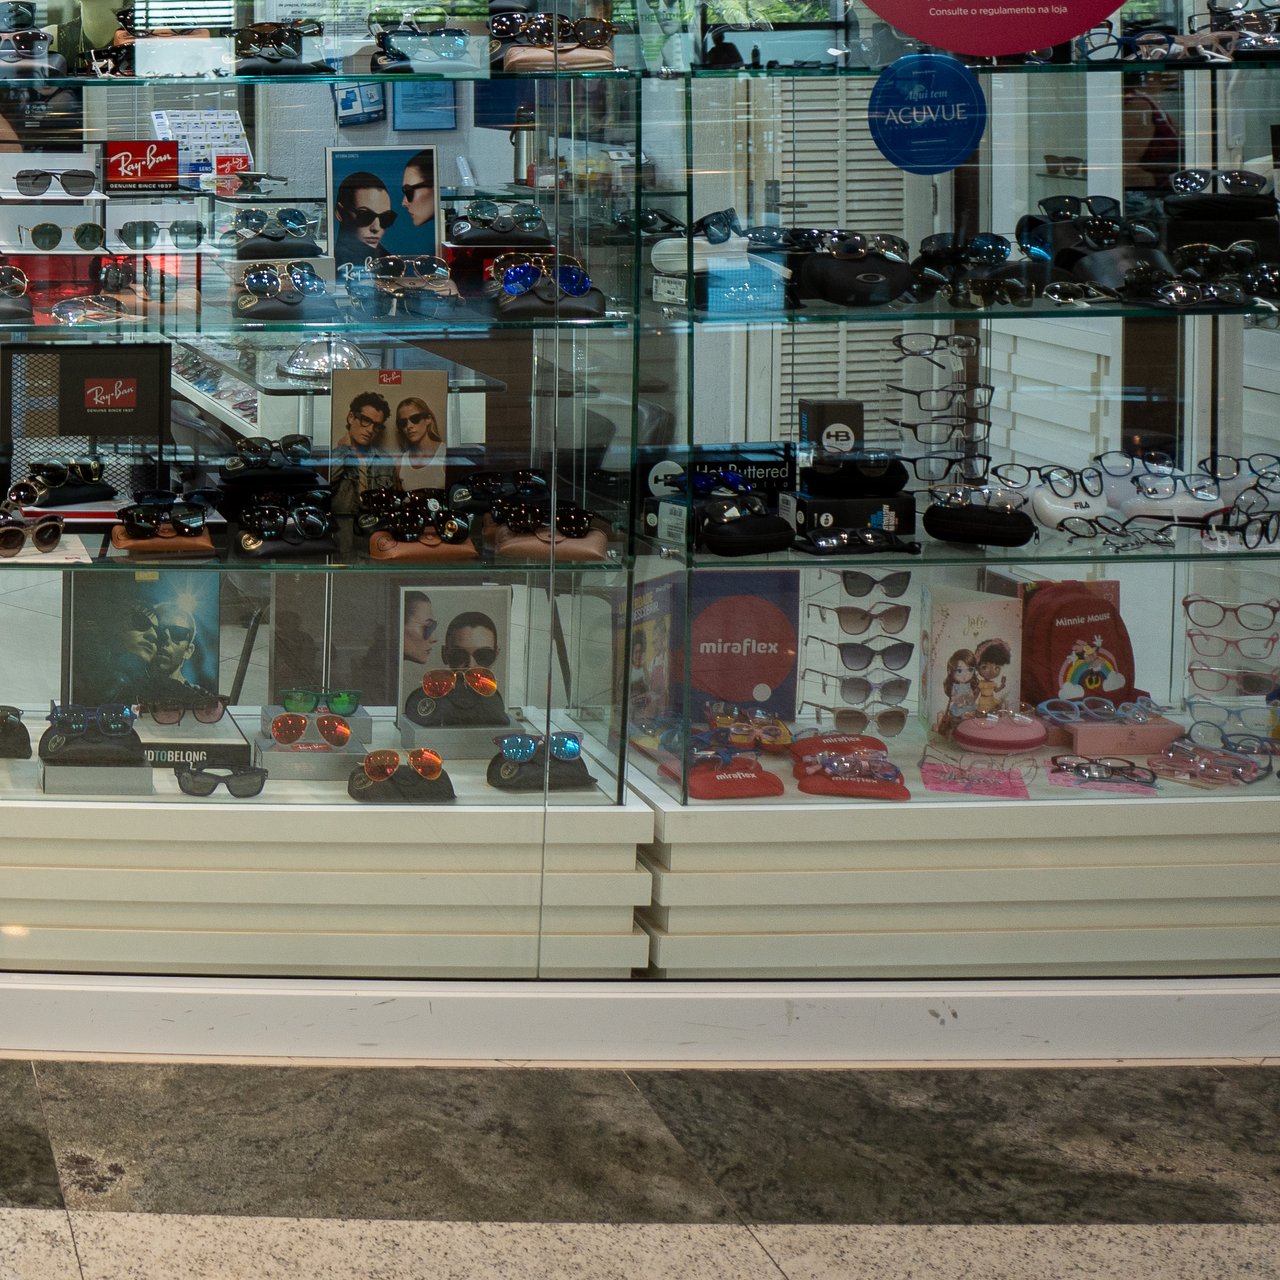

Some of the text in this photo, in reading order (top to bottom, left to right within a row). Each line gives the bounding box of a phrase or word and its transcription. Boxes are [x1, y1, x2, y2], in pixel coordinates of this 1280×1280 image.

[929, 6, 969, 17] Consulte
[979, 5, 1036, 17] regulamento
[1051, 4, 1068, 15] loja
[884, 102, 968, 125] ACUVUE
[1073, 501, 1090, 510] FILA
[1055, 612, 1111, 628] Minnie Mouse
[699, 638, 779, 657] miraflex
[715, 770, 757, 782] miraflex
